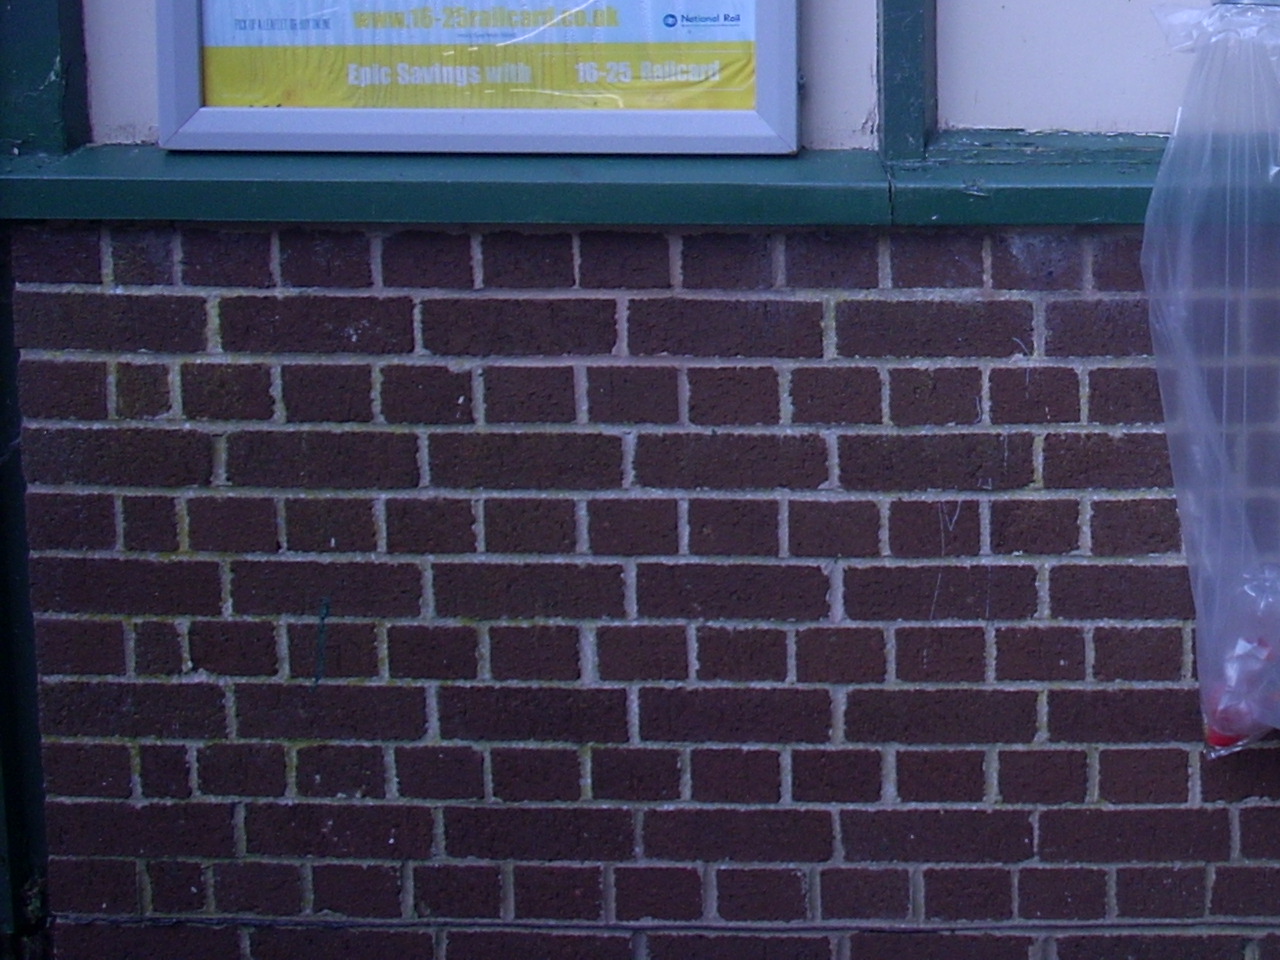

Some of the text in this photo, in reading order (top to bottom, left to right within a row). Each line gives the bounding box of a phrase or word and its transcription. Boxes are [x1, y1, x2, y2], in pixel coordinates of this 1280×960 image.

[681, 14, 741, 23] National Rail
[347, 62, 532, 87] Epic Savings with
[575, 60, 720, 83] 16-25 Railcard
